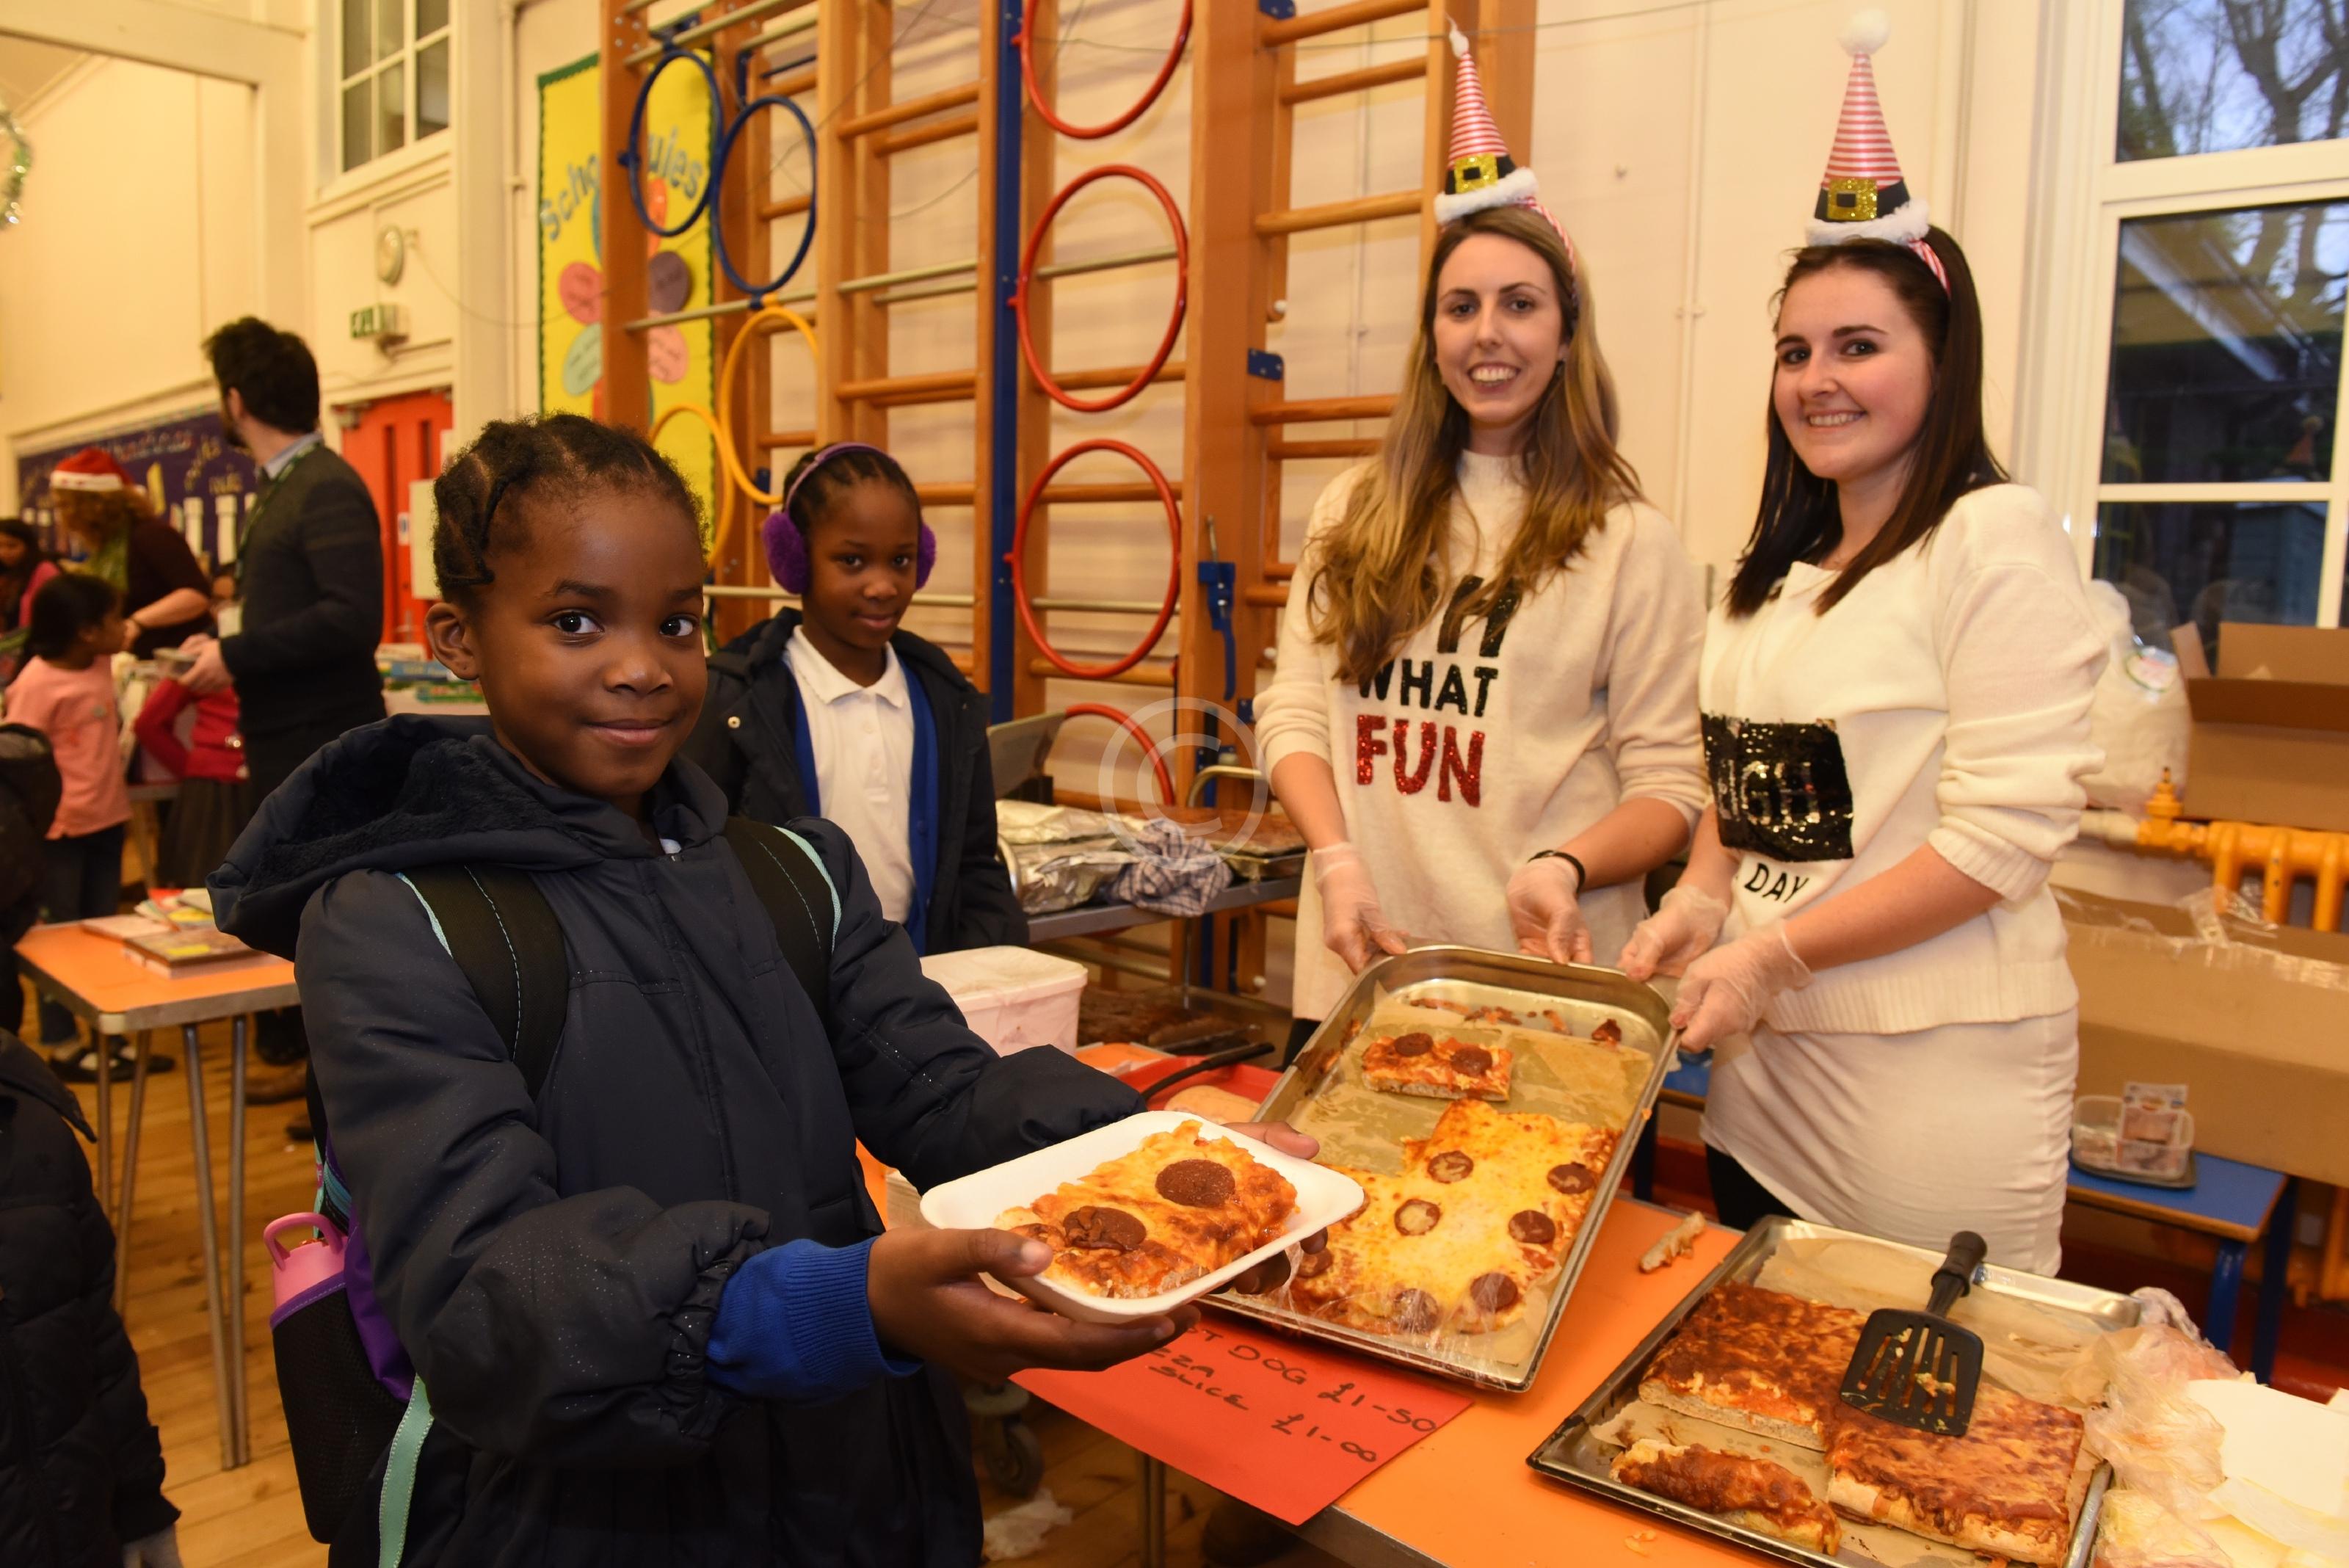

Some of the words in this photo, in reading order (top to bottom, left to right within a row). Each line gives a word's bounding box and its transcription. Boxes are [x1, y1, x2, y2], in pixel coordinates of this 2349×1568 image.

[540, 154, 600, 242] Scho
[647, 125, 703, 200] ules
[1357, 714, 1486, 807] FUN
[1744, 863, 1809, 903] DAY
[1148, 1366, 1249, 1411] SLICE
[1150, 1347, 1215, 1378] ZZA
[1228, 1344, 1307, 1385] DOG
[1318, 1382, 1437, 1432] £1-50
